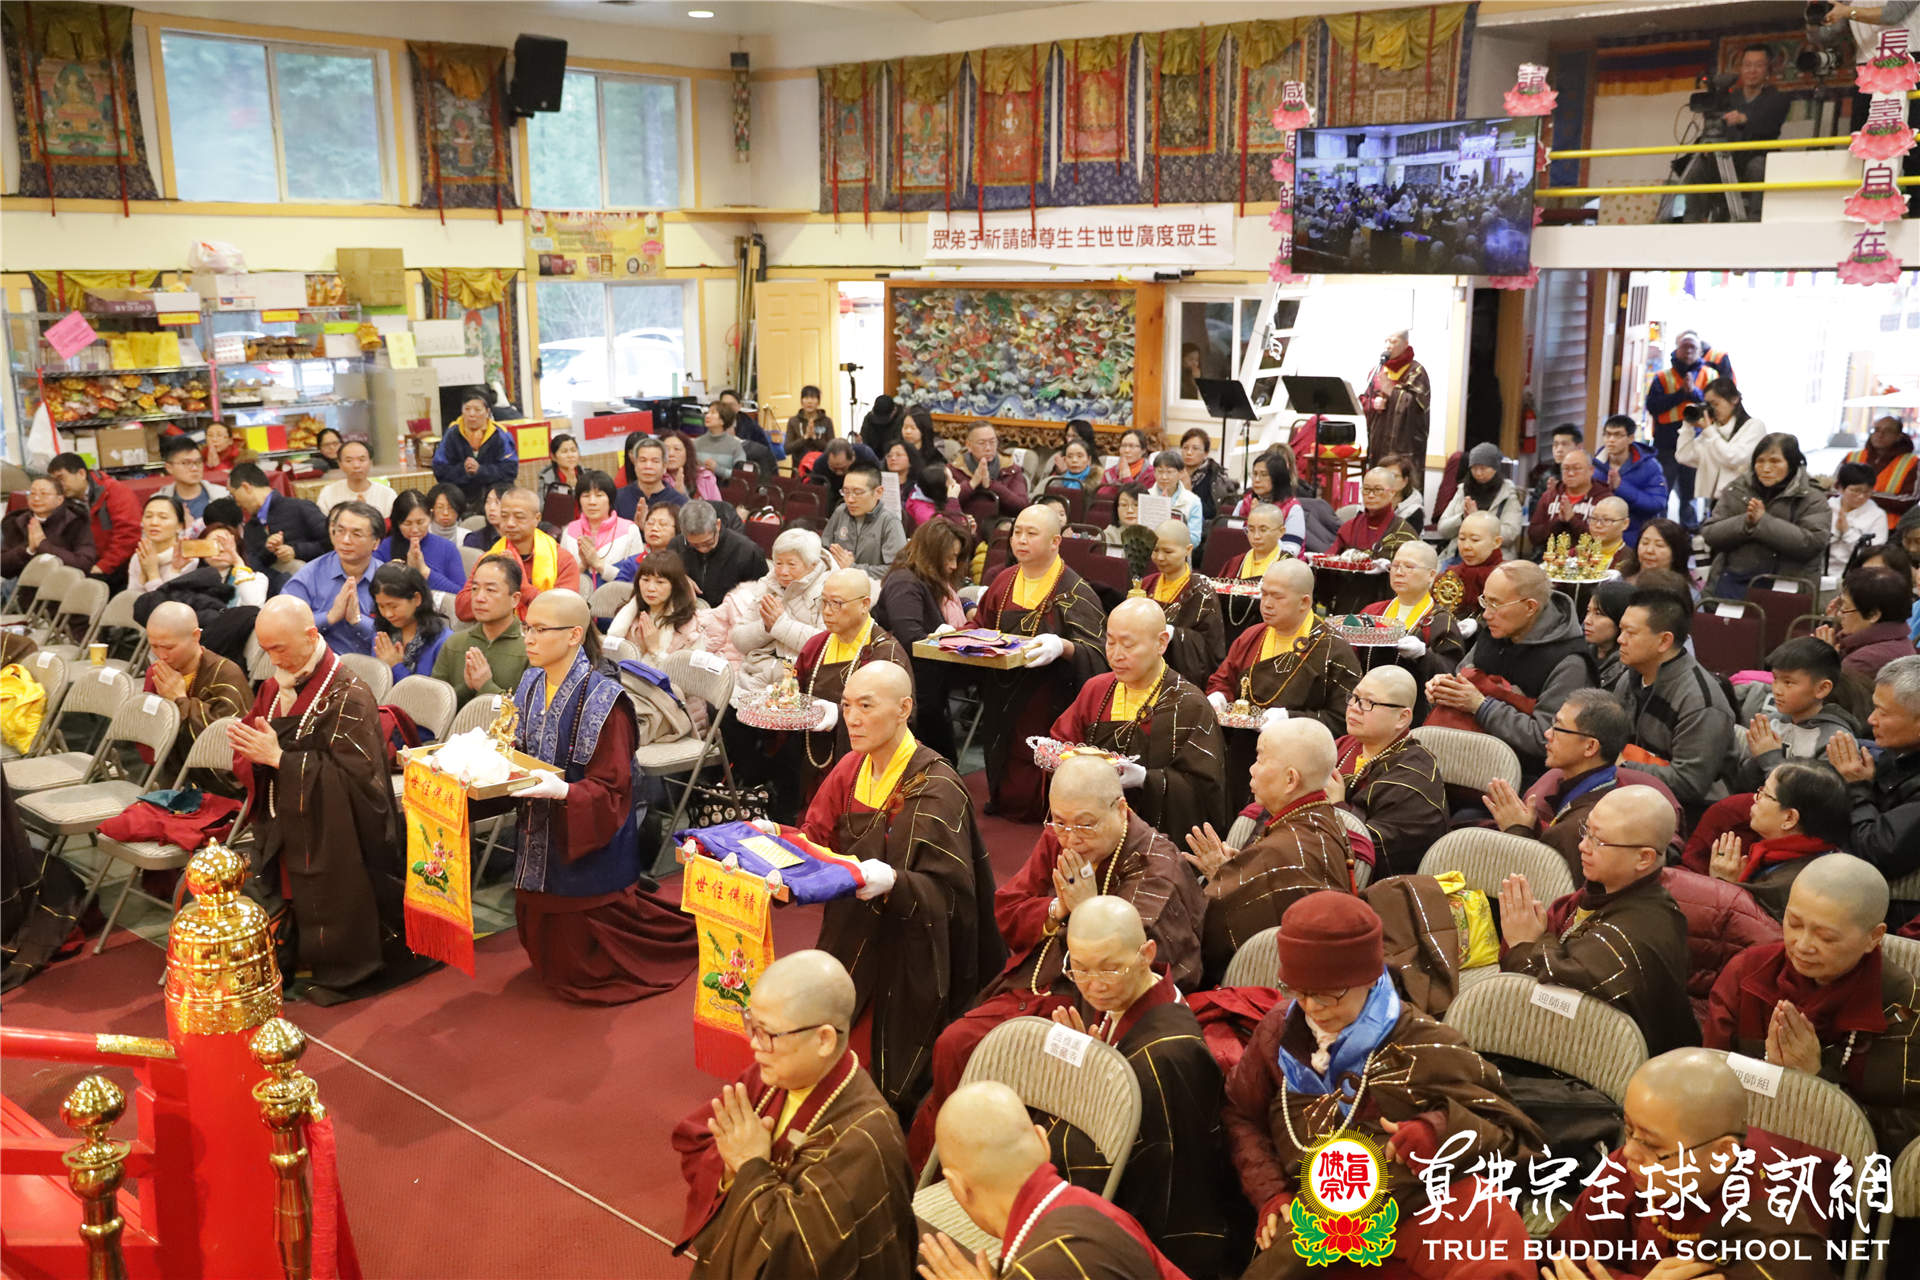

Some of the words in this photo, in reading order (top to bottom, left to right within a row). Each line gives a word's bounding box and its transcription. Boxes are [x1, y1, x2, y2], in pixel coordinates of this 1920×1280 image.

[932, 224, 1217, 250] 眾弟子祈請師尊生生世世廣度眾生
